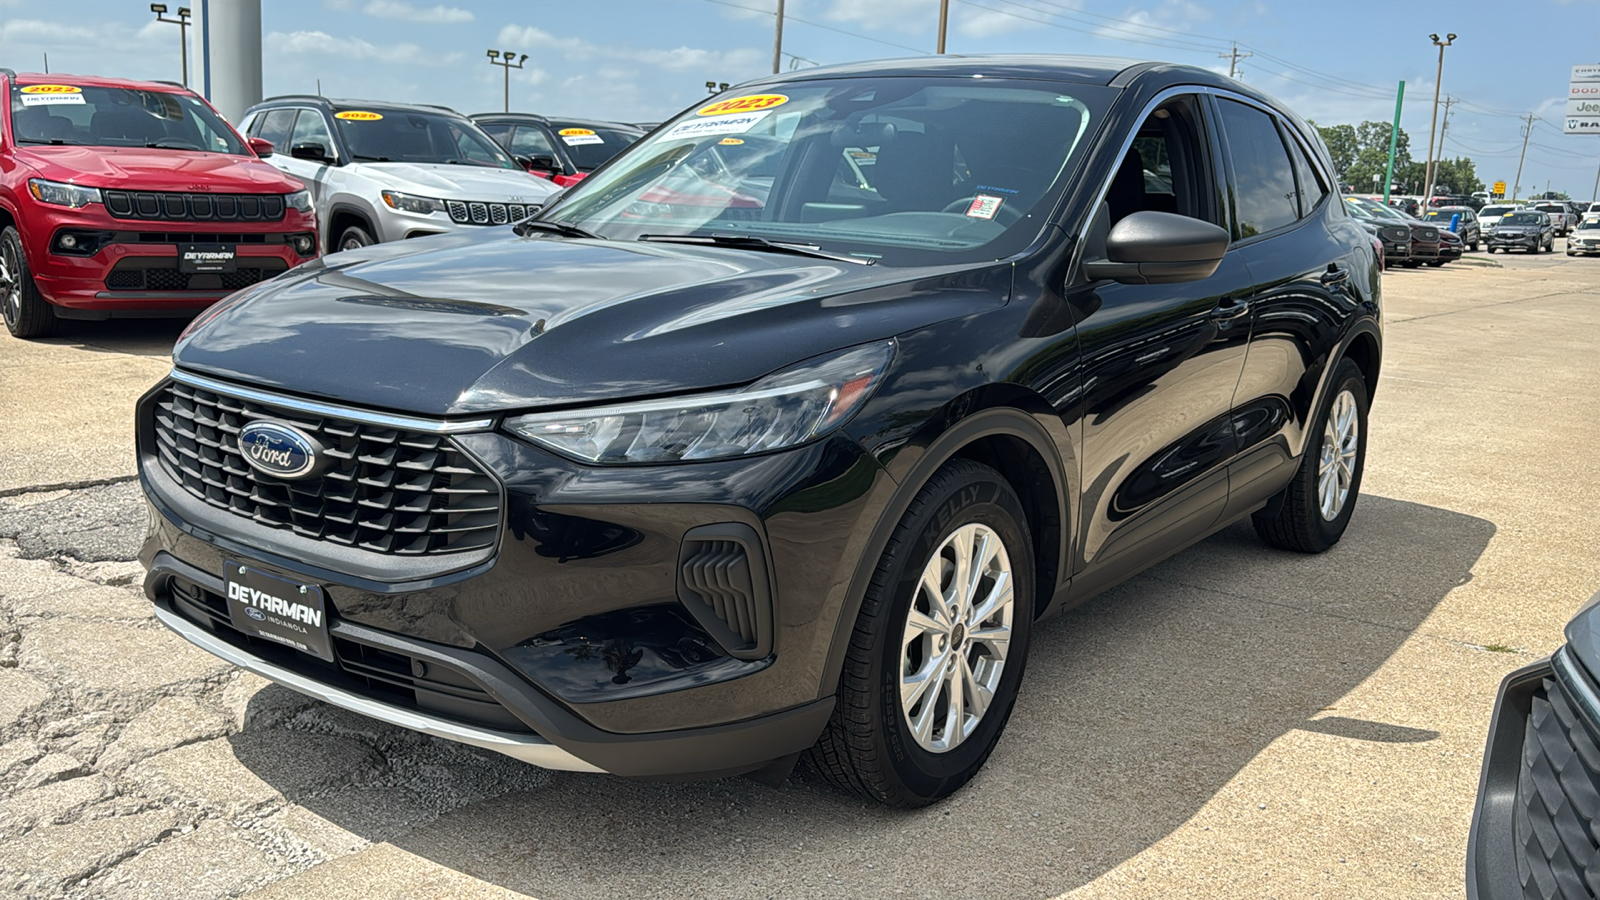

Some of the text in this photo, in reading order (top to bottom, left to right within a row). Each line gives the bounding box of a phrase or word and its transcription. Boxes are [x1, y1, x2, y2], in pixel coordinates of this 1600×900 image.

[702, 97, 782, 114] 2023
[1576, 102, 1600, 114] Jee
[183, 252, 234, 260] DEYARMAN
[251, 433, 293, 467] Ford
[924, 484, 980, 548] KELLY
[228, 581, 322, 628] DEYARMAN
[267, 615, 309, 635] INDIANOLA
